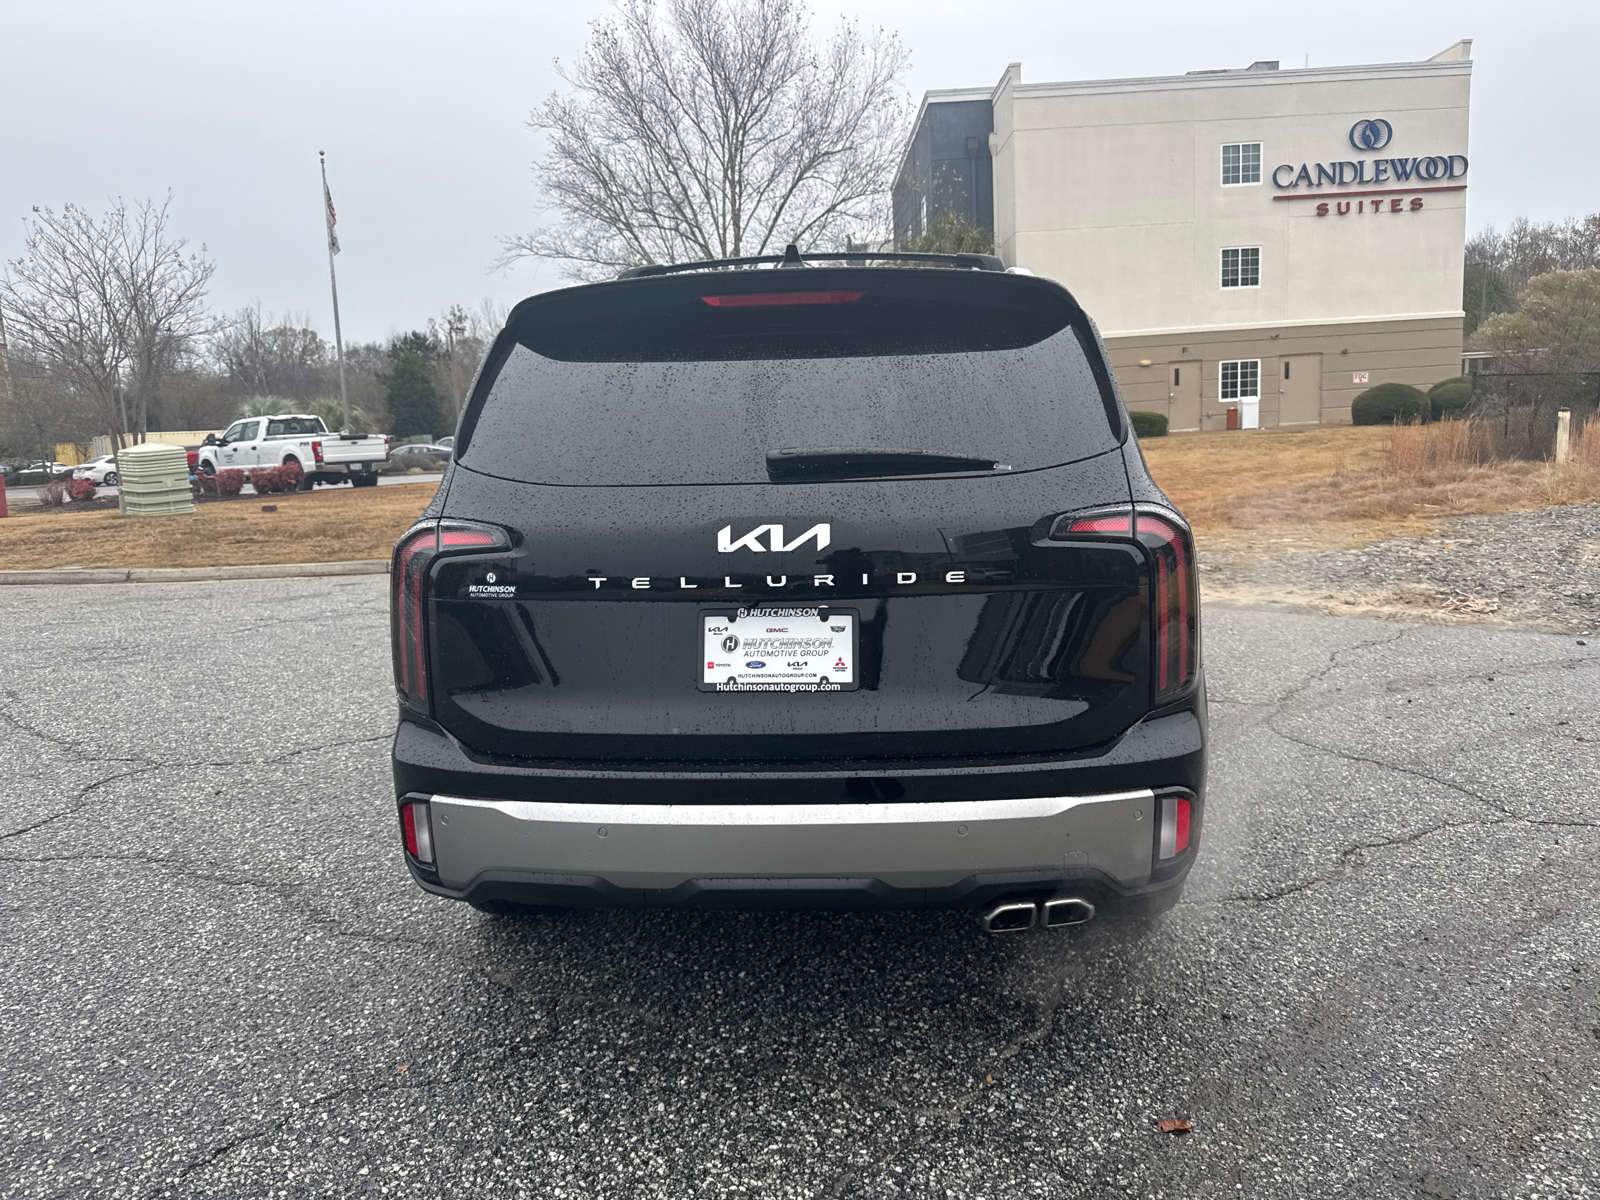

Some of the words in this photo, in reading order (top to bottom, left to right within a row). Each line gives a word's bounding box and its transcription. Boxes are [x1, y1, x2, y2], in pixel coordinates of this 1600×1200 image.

[1272, 154, 1469, 189] CANDLEWOOD
[1316, 197, 1424, 217] SUITES
[717, 523, 831, 553] KIA
[588, 570, 966, 590] TELLURIDE
[469, 585, 516, 593] HUTCHINSON
[749, 608, 819, 617] HUTCHINSON
[742, 638, 834, 650] HUTCHINSON
[800, 649, 829, 657] GROUP
[716, 682, 841, 693] Hutchinsonautogroup.com
